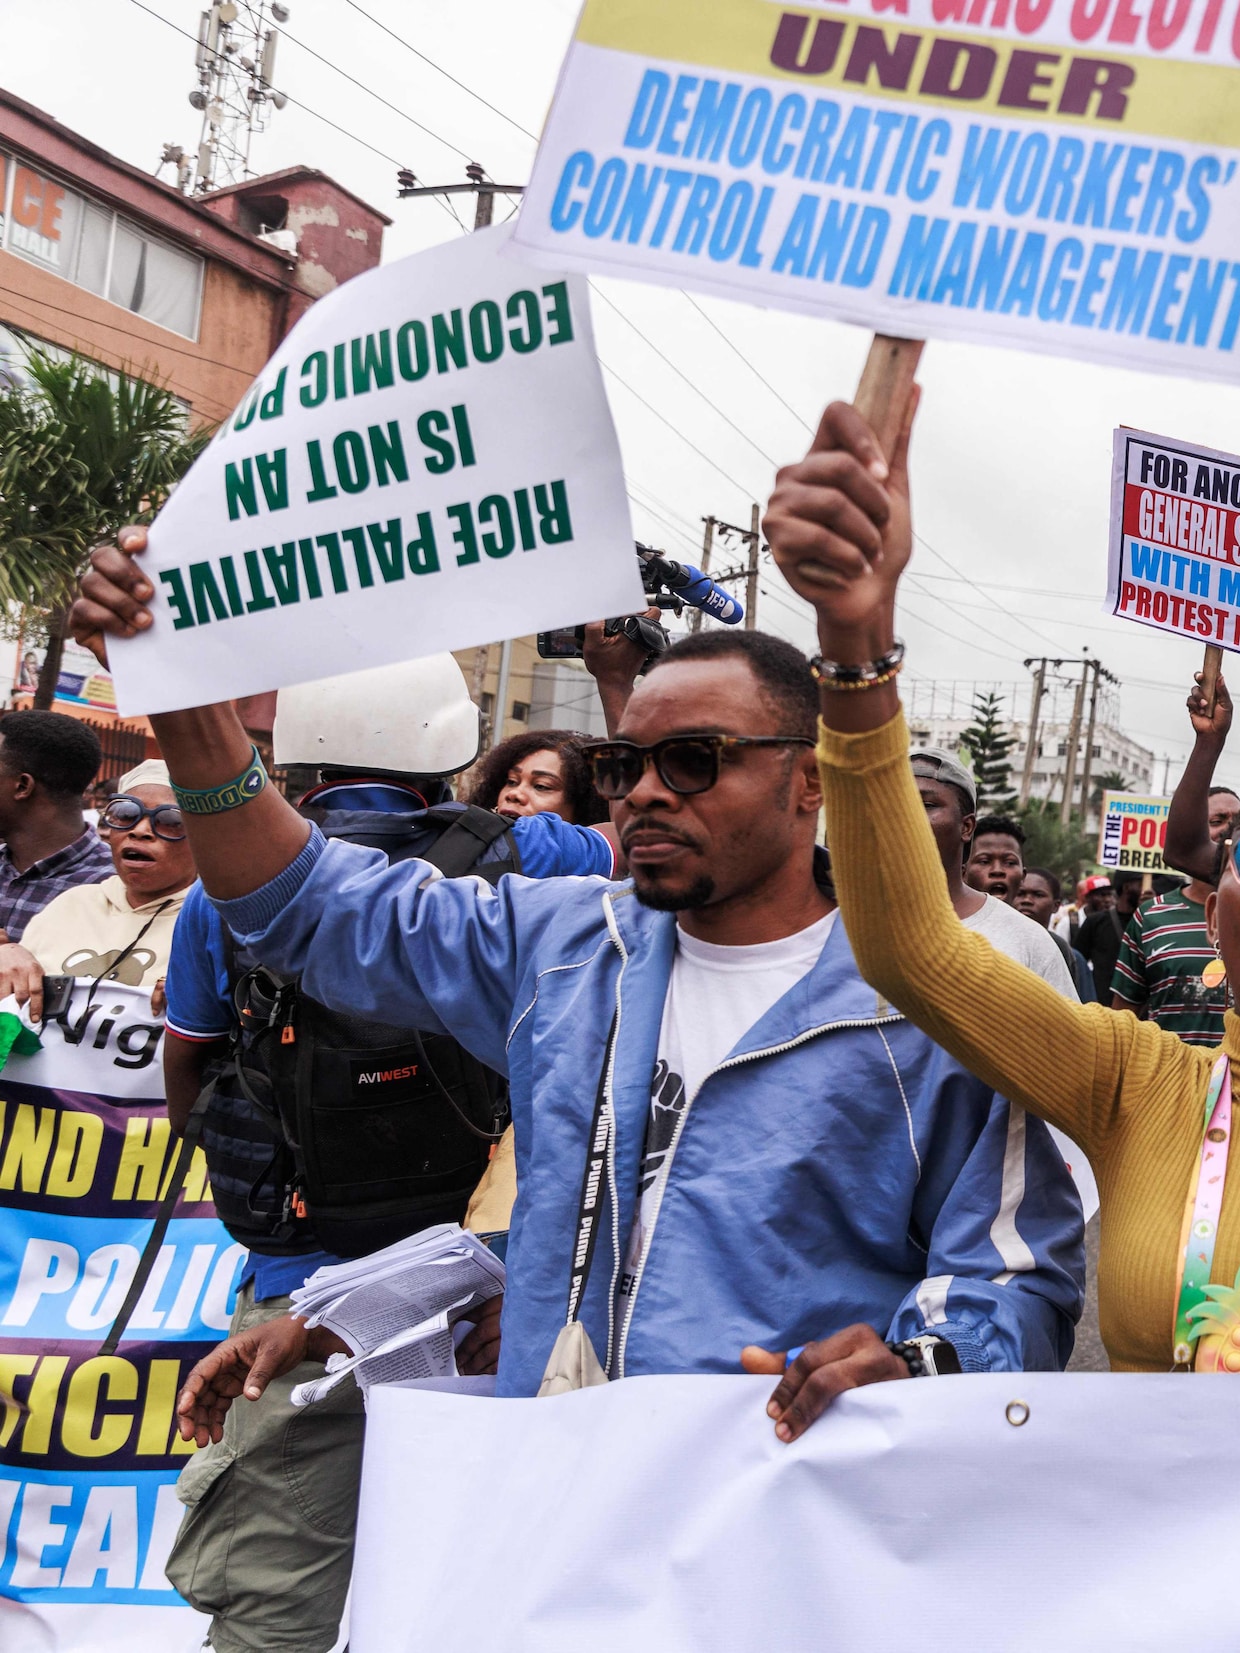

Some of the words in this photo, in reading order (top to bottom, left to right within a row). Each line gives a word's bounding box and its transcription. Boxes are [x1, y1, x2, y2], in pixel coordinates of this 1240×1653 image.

[770, 12, 1137, 122] UNDER
[623, 68, 952, 203] DEMOCRATIC
[549, 150, 776, 270] CONTROL
[770, 192, 891, 289] AND
[298, 280, 574, 409] ECONOMIC
[218, 365, 289, 441] PO
[306, 420, 410, 503] NOT
[416, 404, 477, 476] IS
[1140, 450, 1188, 493] FOR
[224, 447, 290, 521] AN
[446, 479, 574, 568] RICE
[1138, 489, 1228, 560] GENERAL
[158, 511, 442, 631] PALLIATIVE
[1130, 542, 1211, 599] WITH
[1119, 581, 1229, 640] PROTEST
[1105, 814, 1121, 840] THE
[1110, 801, 1161, 816] PRESIDENT
[1103, 844, 1118, 866] LET
[358, 1065, 418, 1084] AVIWEST
[0, 1101, 104, 1198] ND
[583, 1158, 603, 1210] PUMA
[575, 1215, 593, 1269] PUMA
[0, 1354, 200, 1458] TICI
